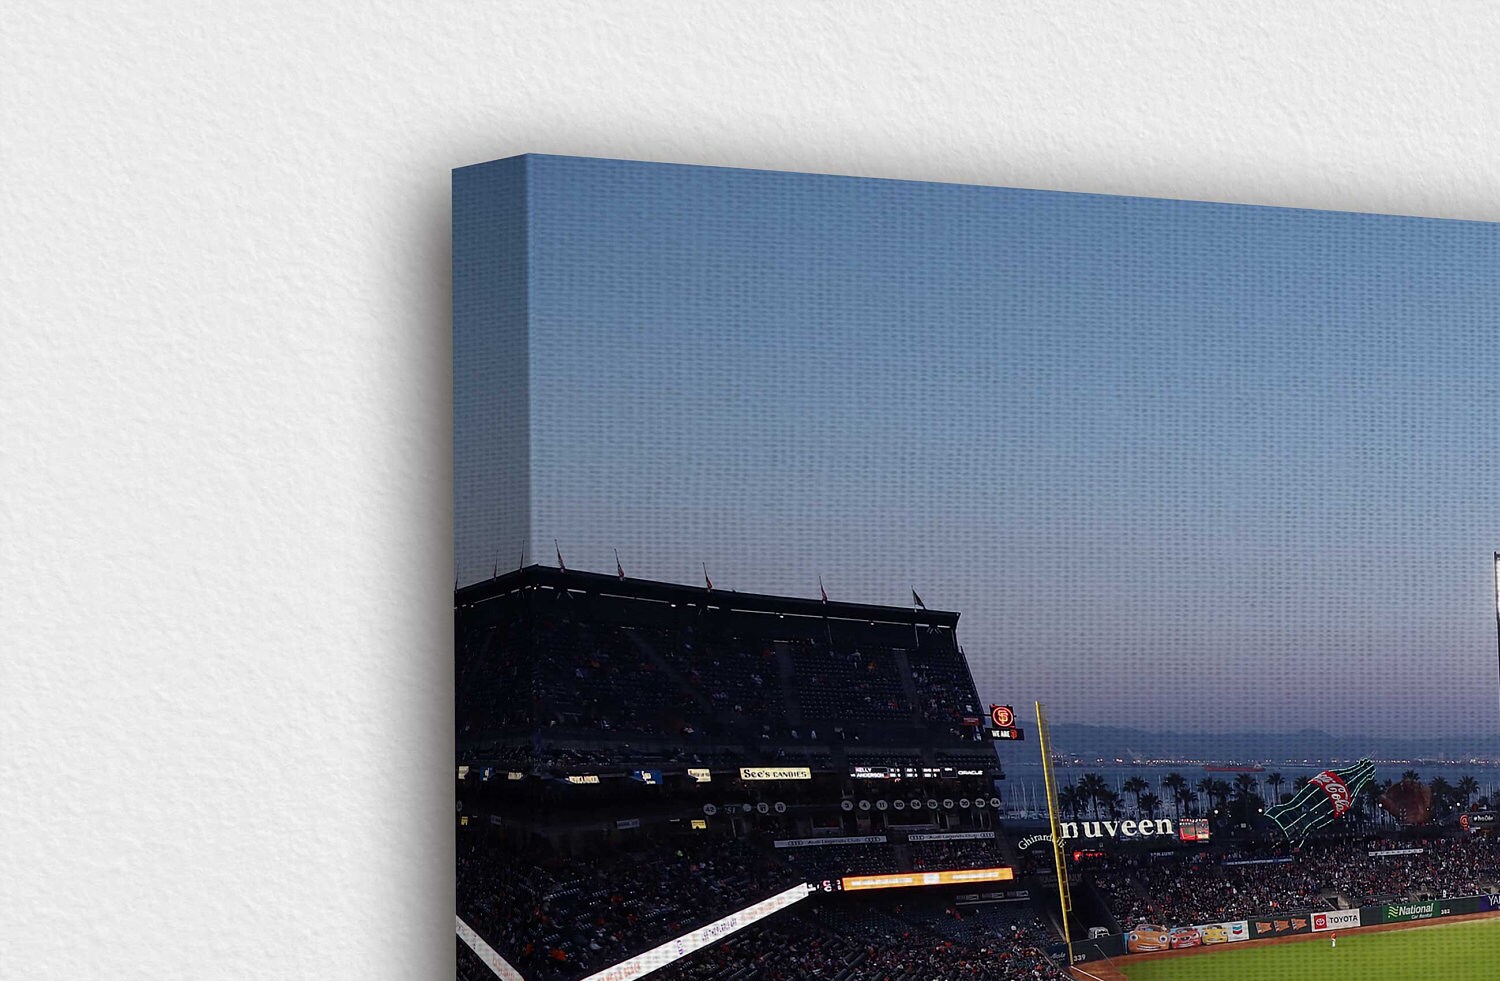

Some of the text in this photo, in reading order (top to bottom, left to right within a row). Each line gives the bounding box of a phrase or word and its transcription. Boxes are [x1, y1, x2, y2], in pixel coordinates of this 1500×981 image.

[743, 768, 807, 778] See's CANDIES
[1060, 817, 1175, 839] nuveen
[1017, 833, 1067, 850] Ghirardlli
[1398, 902, 1434, 916] National
[1329, 914, 1358, 924] TOYOTA
